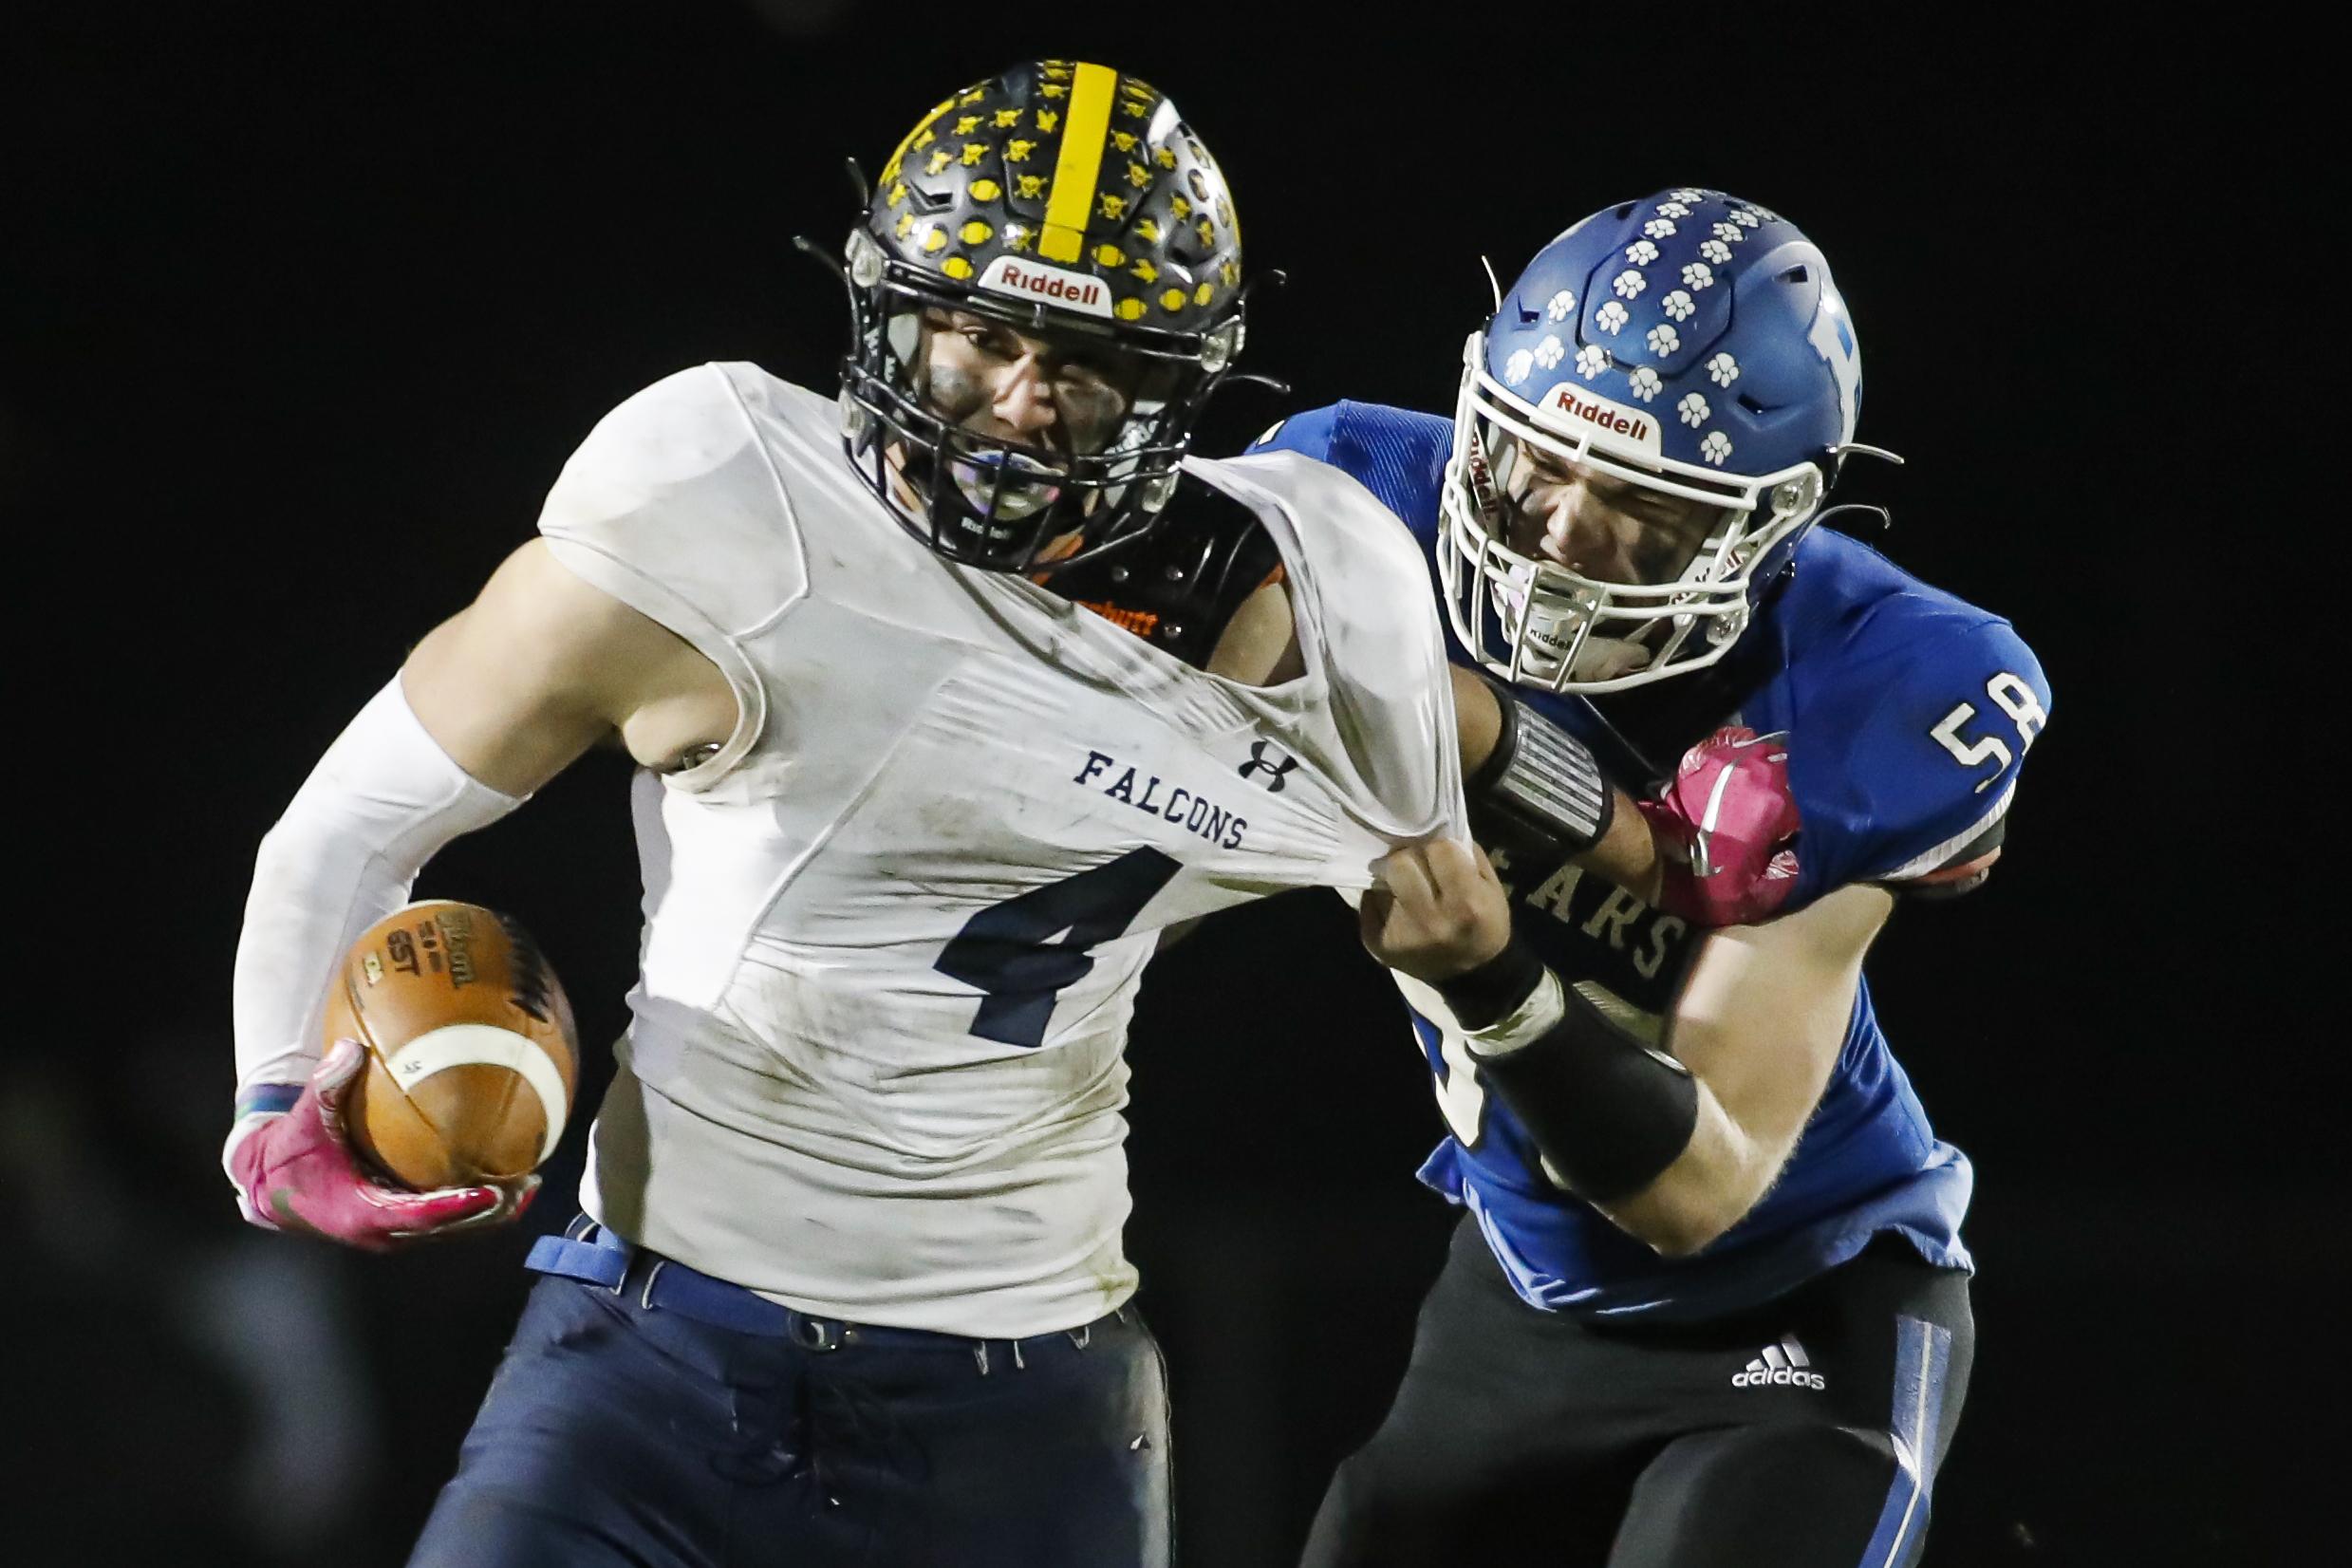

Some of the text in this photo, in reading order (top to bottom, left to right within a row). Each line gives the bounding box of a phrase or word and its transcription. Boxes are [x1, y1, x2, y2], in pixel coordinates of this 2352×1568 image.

[1001, 264, 1099, 306] Riddell
[1557, 390, 1648, 441] Riddell
[1930, 671, 2047, 793] 58
[1073, 750, 1247, 849] FALCONS
[932, 845, 1184, 1048] 4
[1491, 848, 1687, 979] ARS
[1731, 1365, 1825, 1391] adidas
